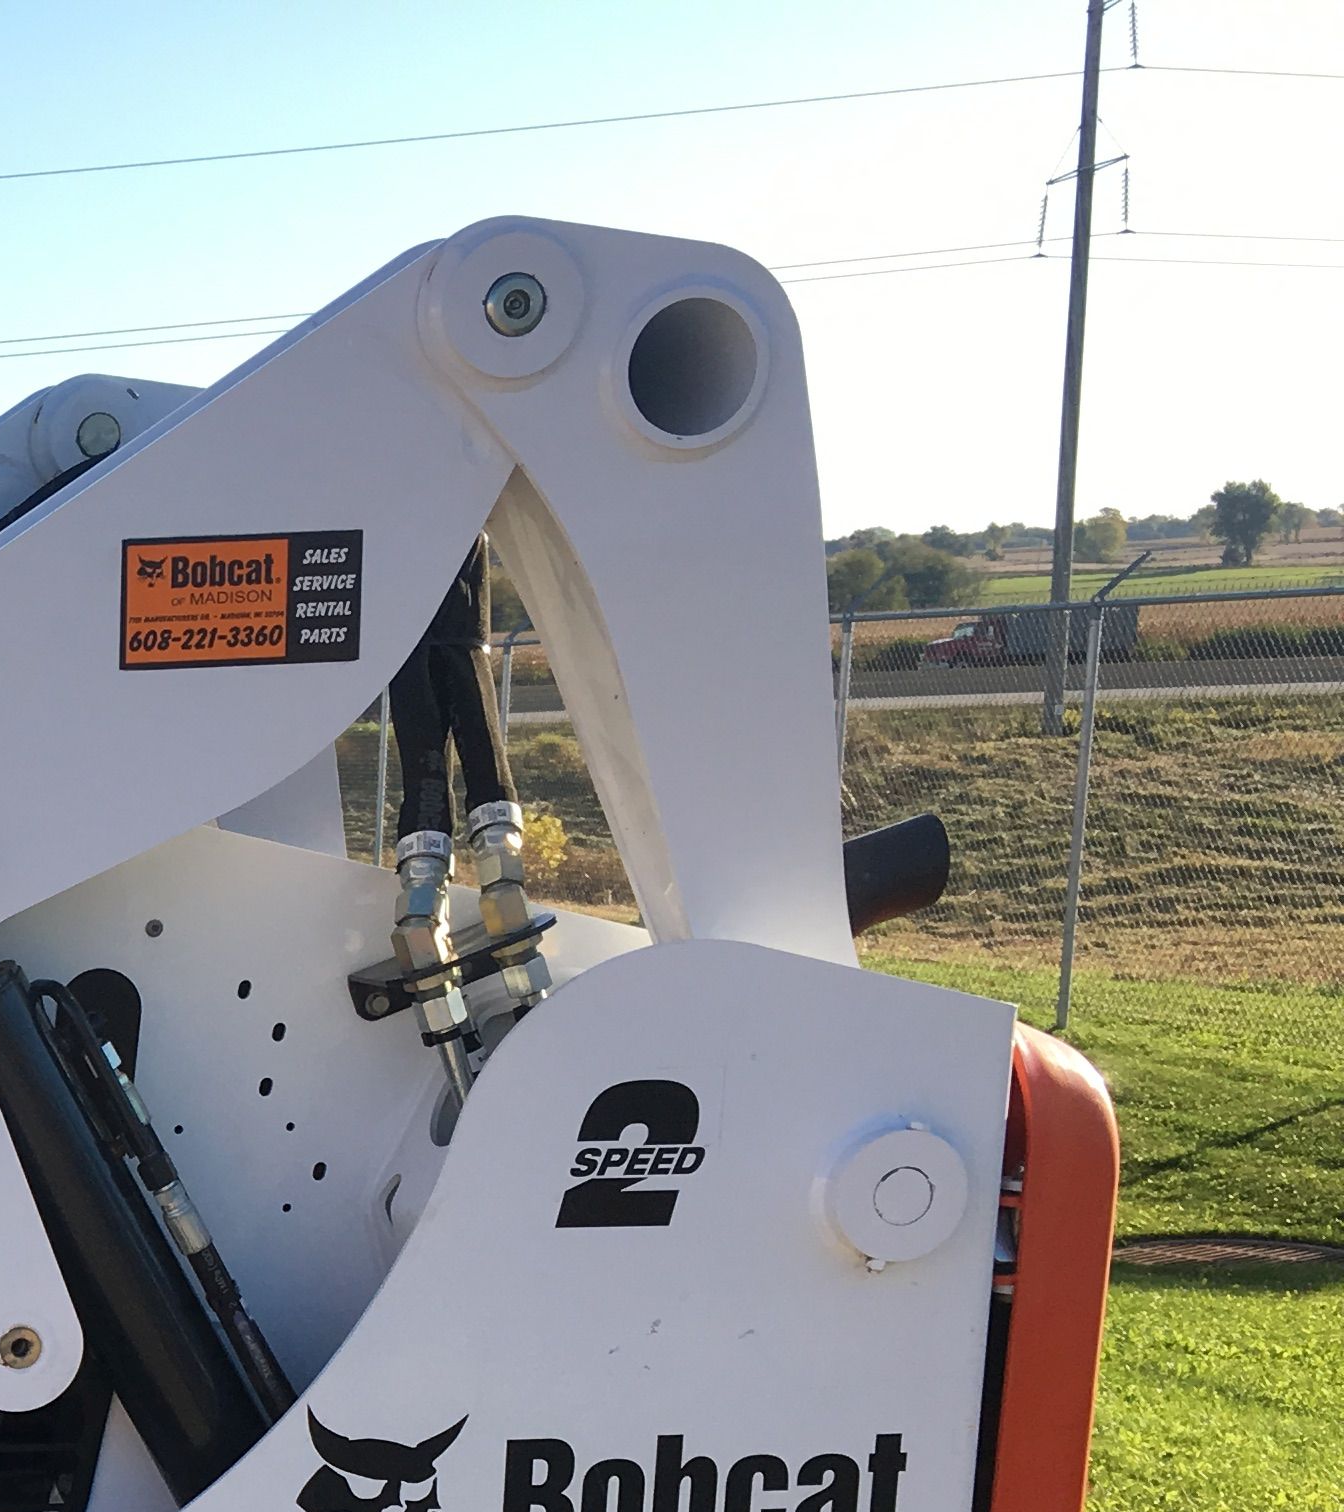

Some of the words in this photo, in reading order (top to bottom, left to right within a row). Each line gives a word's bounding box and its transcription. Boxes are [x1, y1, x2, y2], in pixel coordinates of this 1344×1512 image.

[302, 548, 349, 565] SALES
[170, 553, 275, 589] Bobcat
[292, 574, 356, 592] SERVICE
[189, 589, 273, 606] MADISON
[295, 601, 353, 619] RENTAL
[128, 624, 284, 652] 608-221-3360
[299, 628, 348, 645] PARTS
[555, 1079, 700, 1228] 2
[569, 1146, 706, 1178] SPEED
